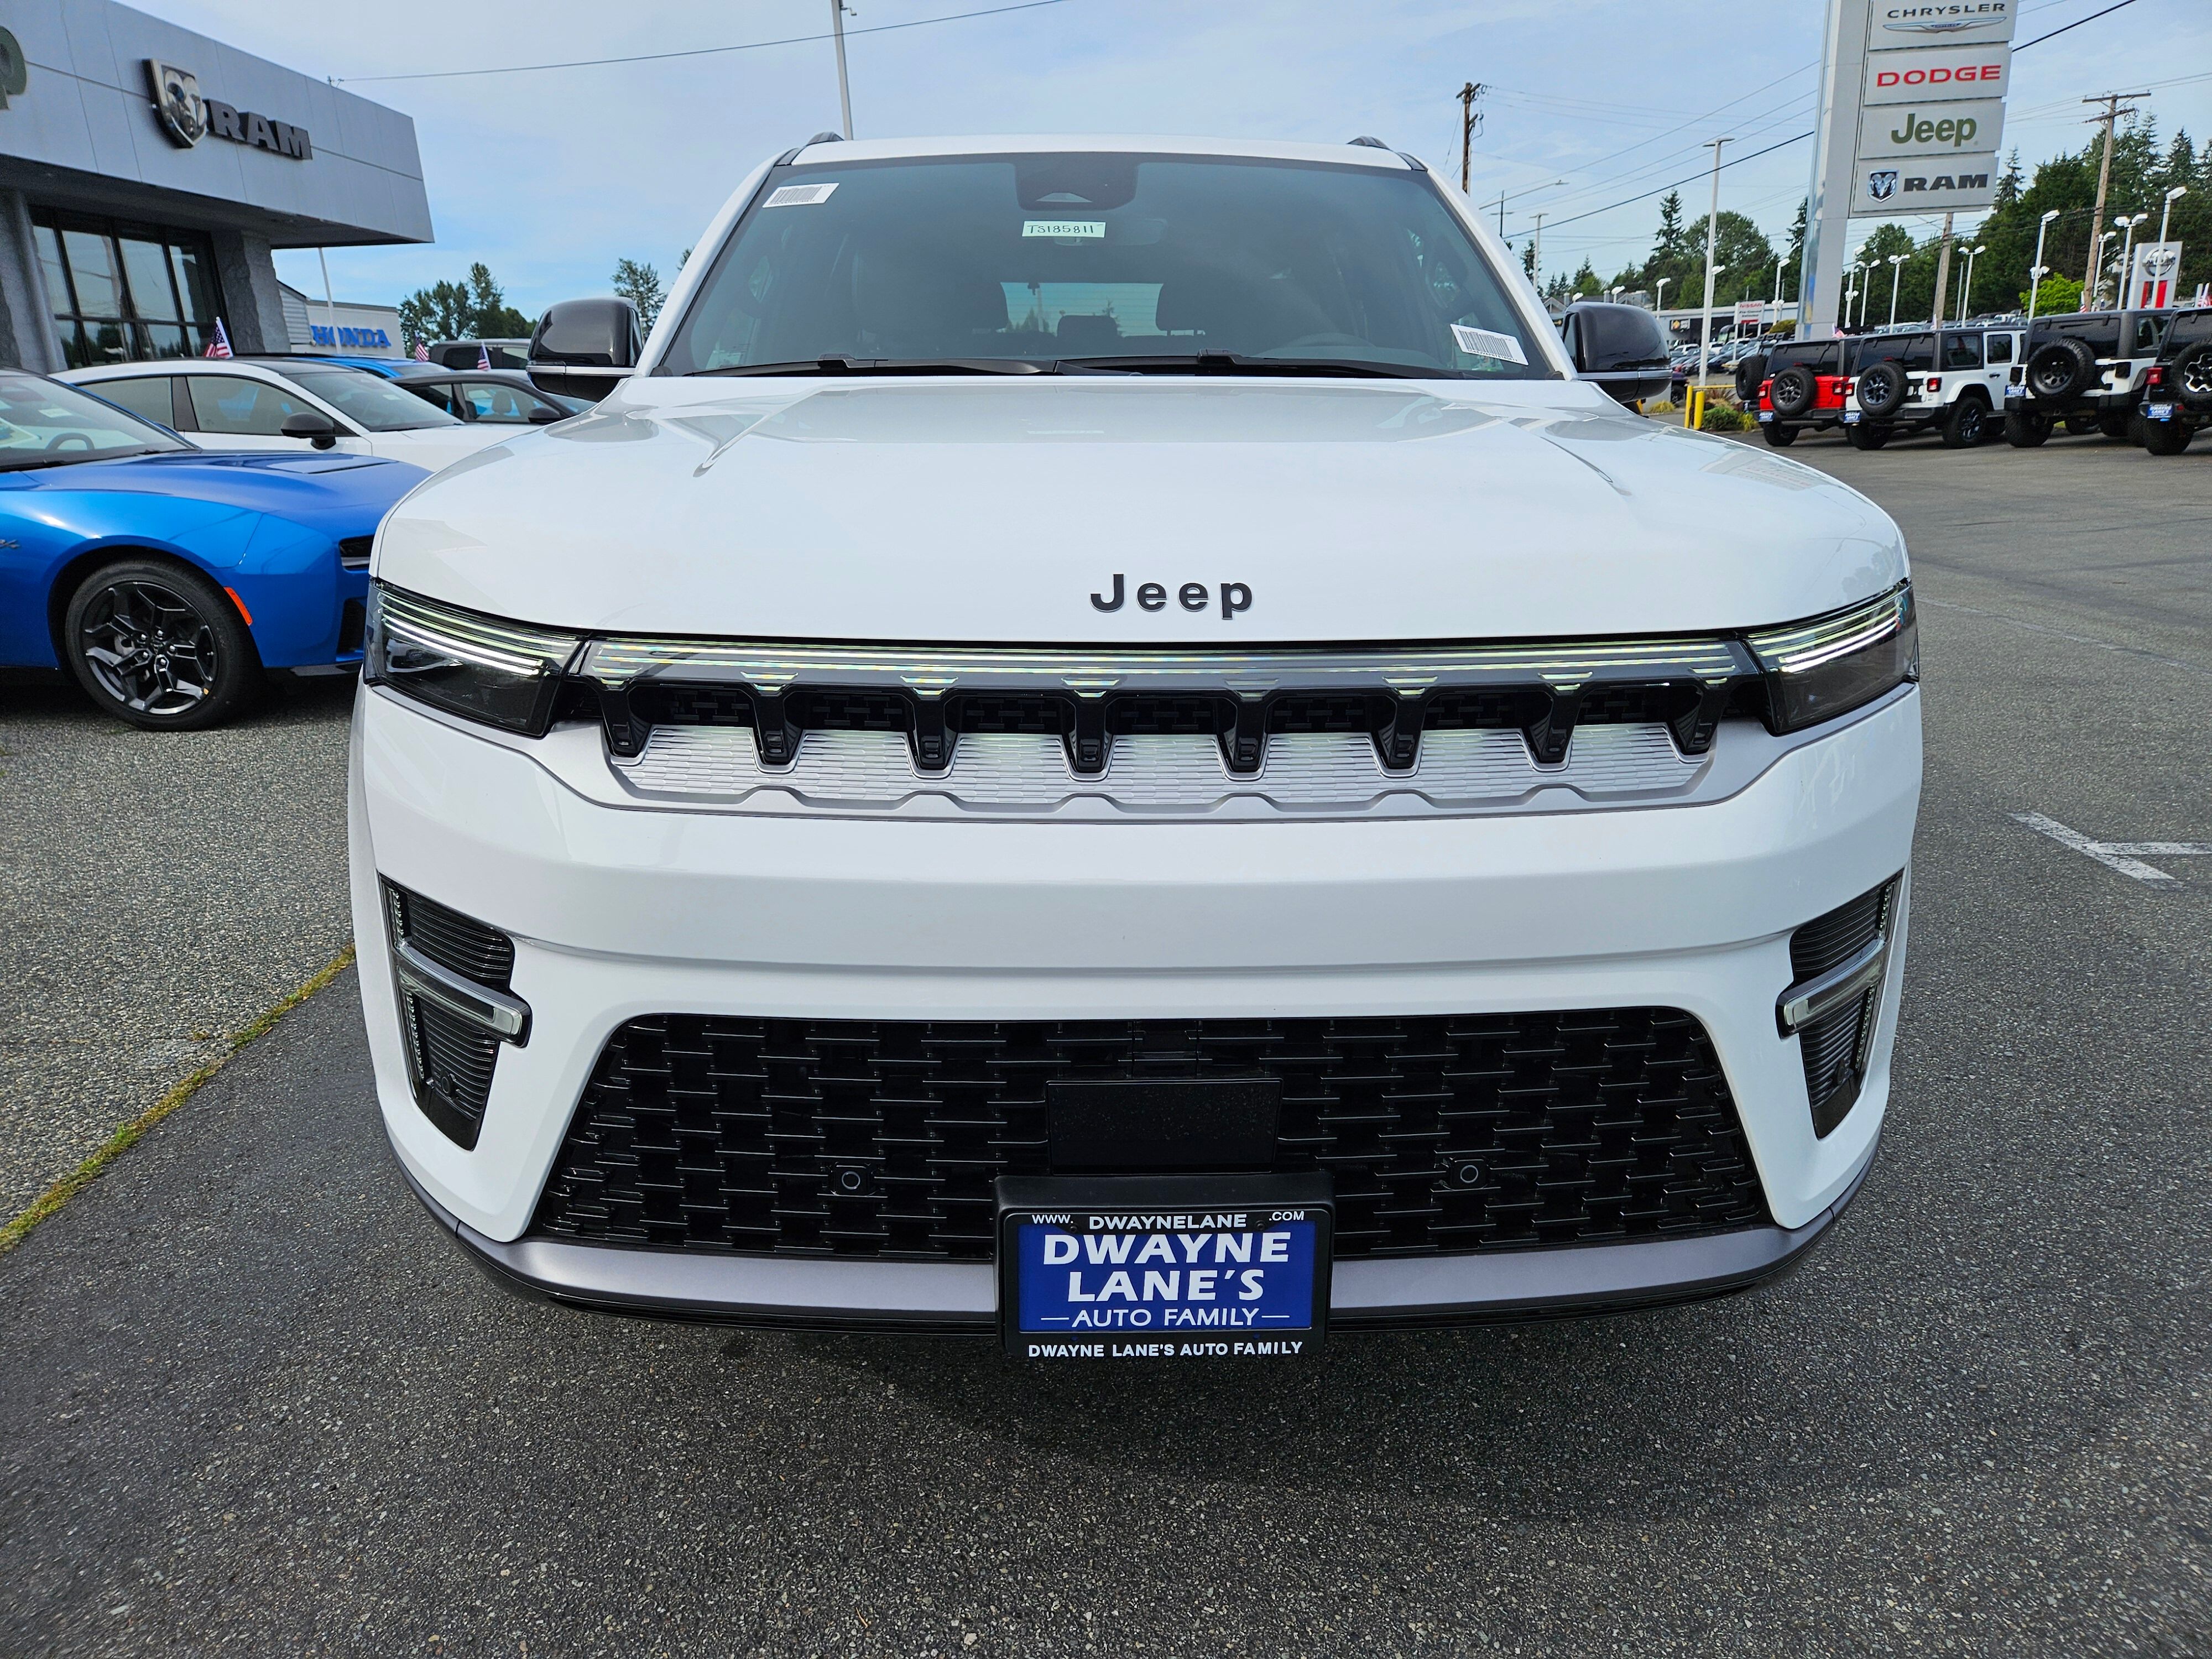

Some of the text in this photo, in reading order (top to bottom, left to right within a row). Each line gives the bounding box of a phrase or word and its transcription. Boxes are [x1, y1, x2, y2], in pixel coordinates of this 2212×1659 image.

[1887, 3, 2005, 18] CHRYSLER
[1877, 65, 2001, 87] DODGE
[204, 98, 313, 159] RAM
[1891, 113, 1977, 147] Jeep
[1903, 174, 1989, 192] RAM
[1027, 225, 1093, 233] TS185811
[310, 325, 392, 347] HONDA
[1091, 573, 1253, 620] Jeep
[1032, 1211, 1305, 1230] WWW. DWAYNELANE .COM
[1044, 1232, 1291, 1265] DWAYNE
[1068, 1269, 1264, 1302] LANE'S
[1072, 1308, 1260, 1327] AUTO FAMILY
[1029, 1341, 1303, 1357] DWAYNE LANE'S AUTO FAMILY
